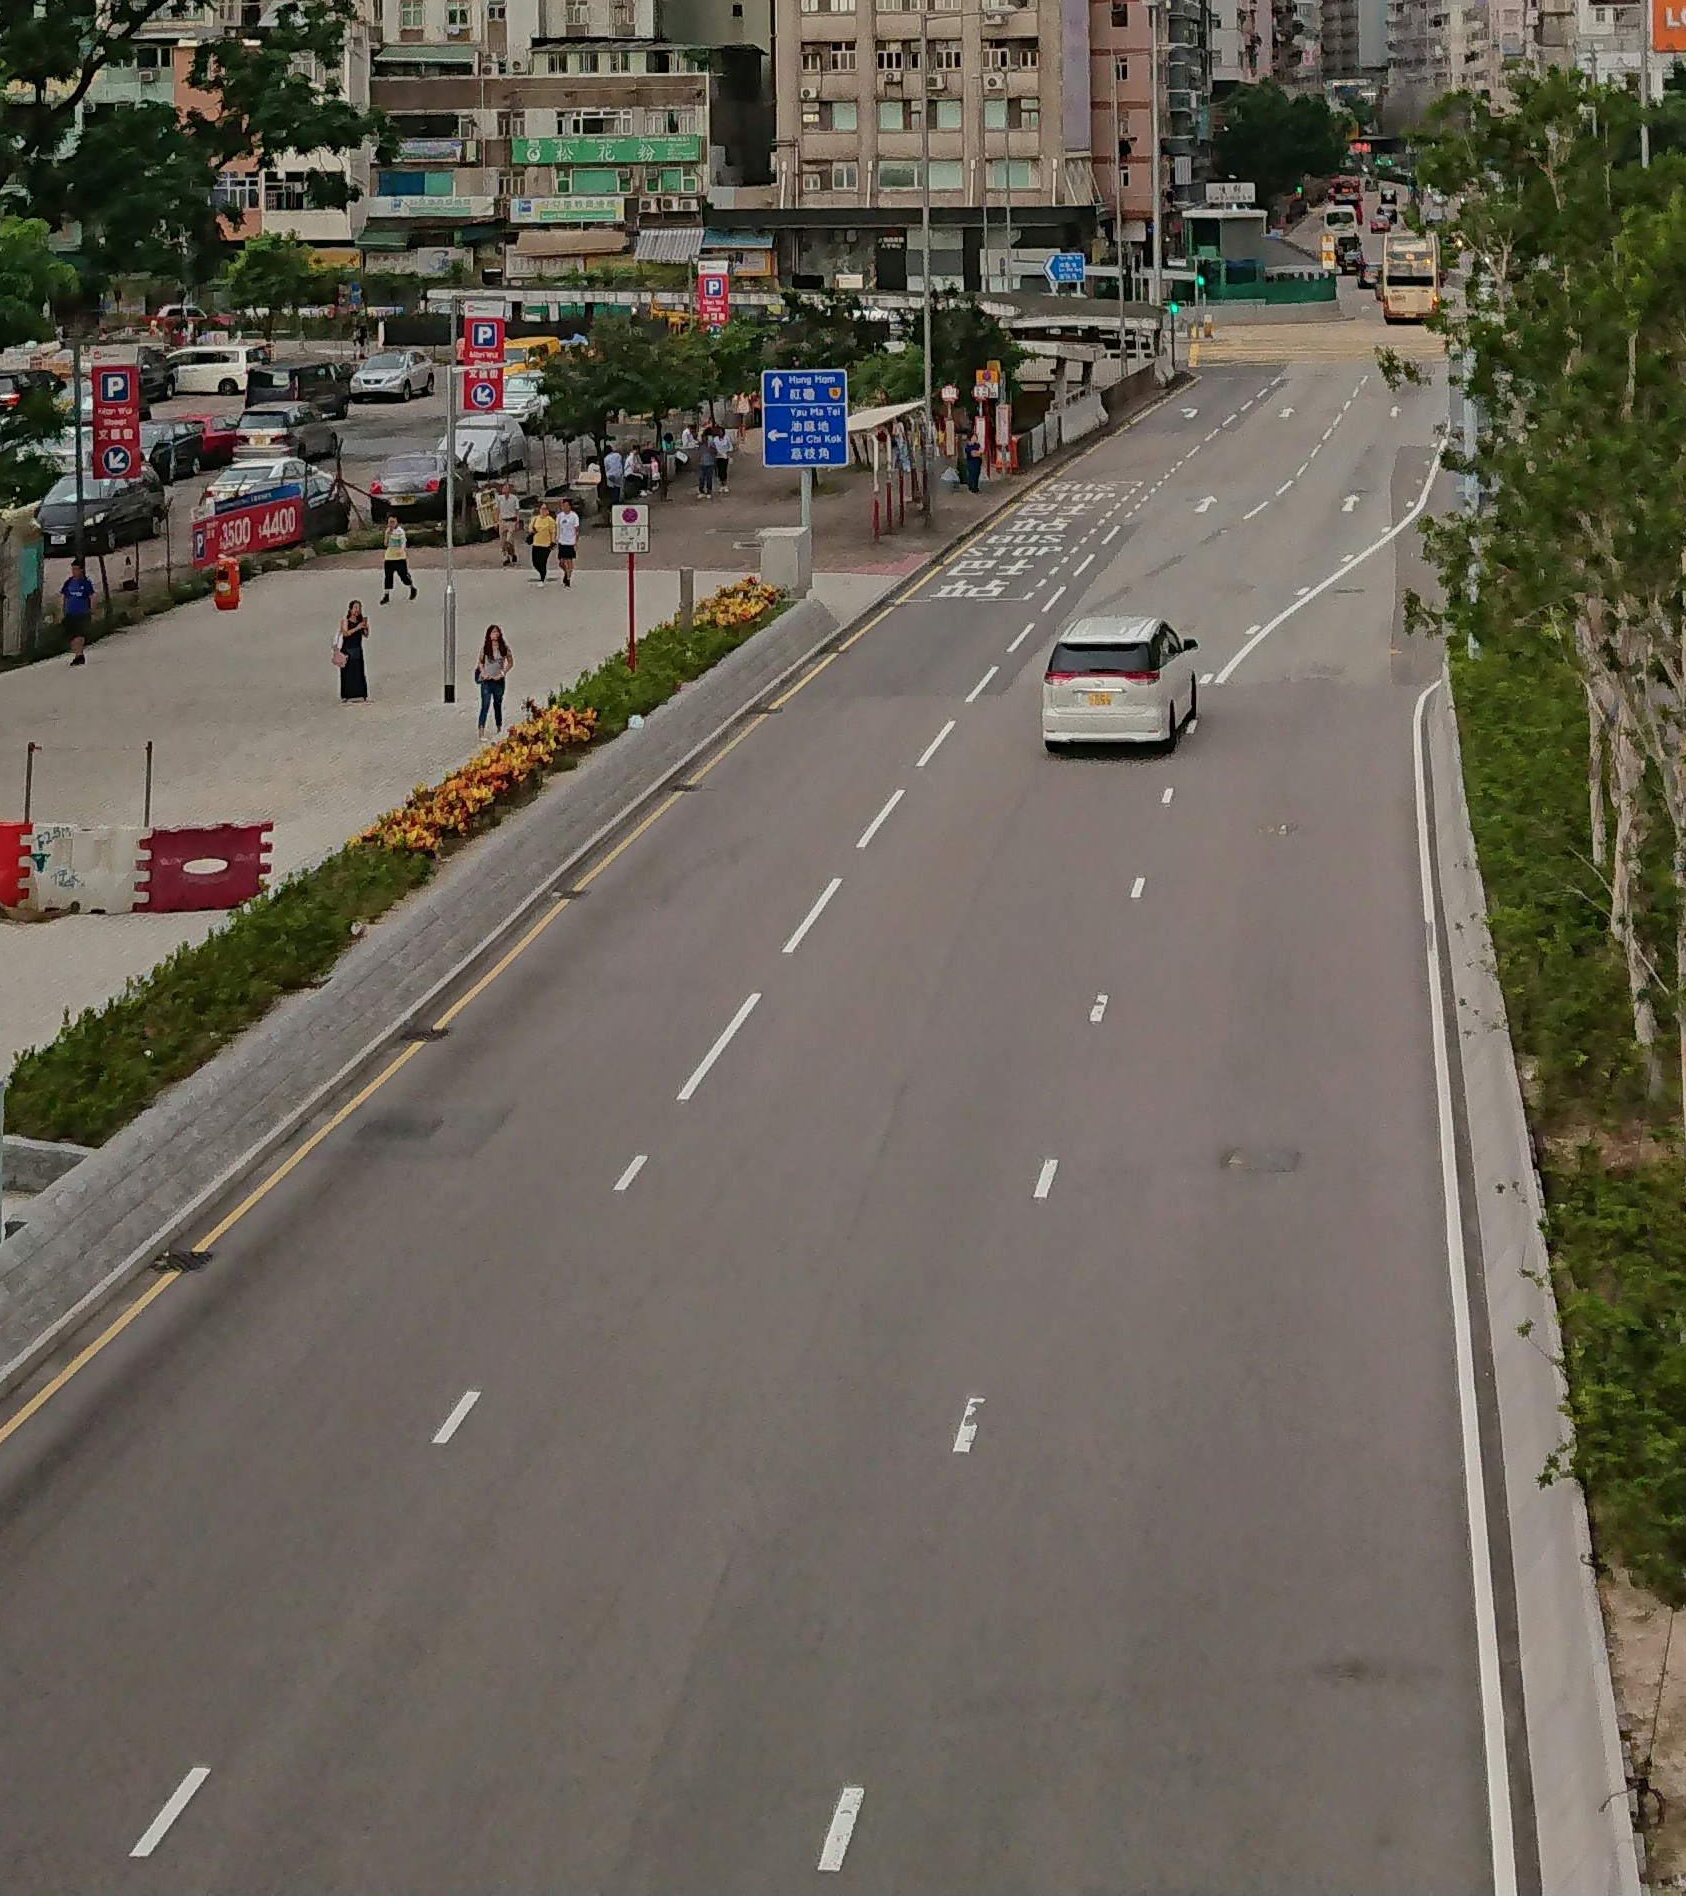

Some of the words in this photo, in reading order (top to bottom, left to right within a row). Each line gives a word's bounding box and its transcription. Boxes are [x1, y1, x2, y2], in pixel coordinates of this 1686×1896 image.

[556, 144, 656, 161] 松花粉
[709, 281, 719, 294] P
[477, 326, 493, 344] P
[788, 375, 812, 385] Hung
[815, 375, 836, 384] Hom
[107, 376, 125, 398] P
[790, 407, 808, 417] Yau
[810, 407, 824, 416] Ma
[827, 407, 841, 416] Tei
[790, 420, 830, 432] 油麻地
[790, 435, 804, 444] Lai
[806, 435, 822, 444] Chi
[825, 435, 842, 444] Kok
[1047, 483, 1118, 492] BUS
[1023, 492, 1116, 502] STOP
[1016, 503, 1095, 516] 巴士
[1006, 518, 1072, 533] 站
[986, 534, 1066, 544] BUS
[963, 546, 1063, 557] STOP
[946, 558, 1034, 576] 巴士
[929, 579, 1010, 598] 站
